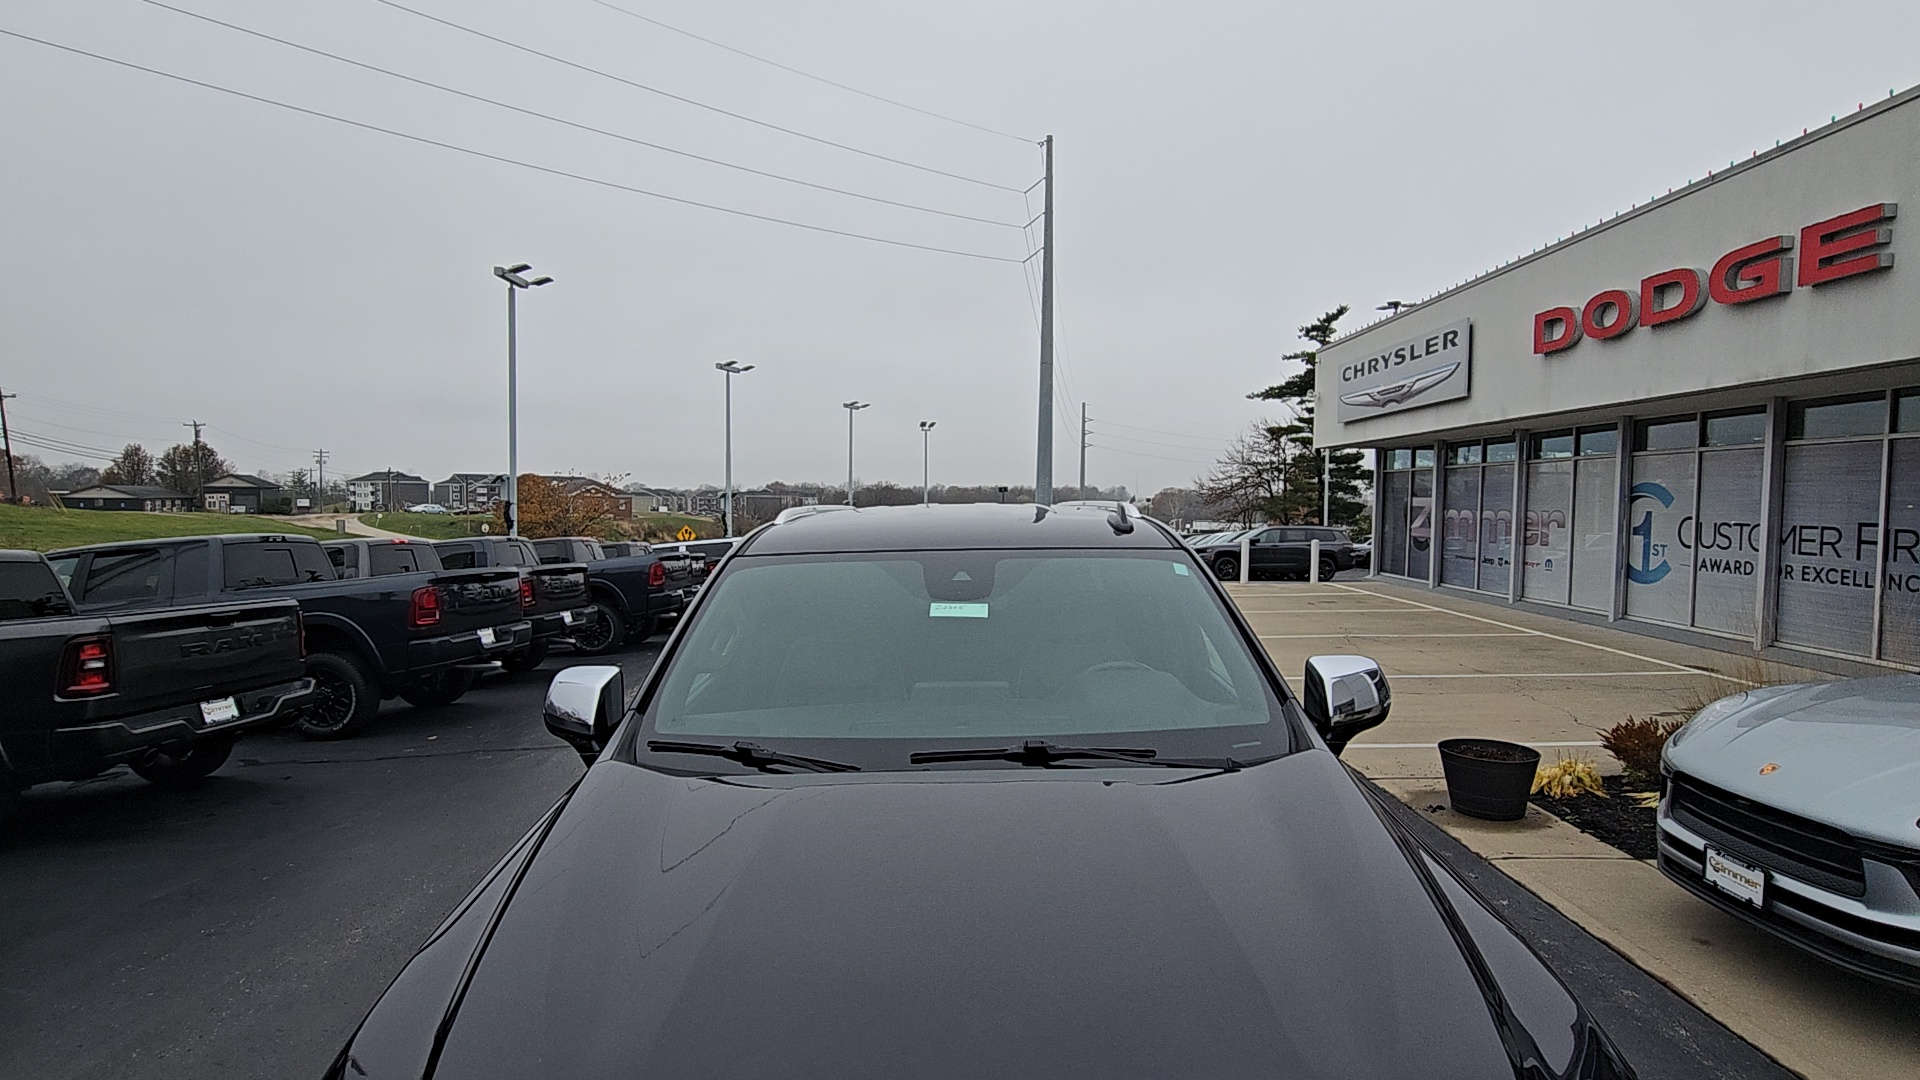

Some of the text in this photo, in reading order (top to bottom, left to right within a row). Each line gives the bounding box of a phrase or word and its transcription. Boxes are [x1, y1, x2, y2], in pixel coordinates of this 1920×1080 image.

[1534, 203, 1897, 355] DODGE
[1342, 330, 1459, 382] CHRYSLER
[1411, 497, 1566, 546] Zmmer
[1699, 557, 1754, 576] AWARD
[1801, 565, 1920, 593] EXCELLNC
[180, 633, 263, 658] RAM
